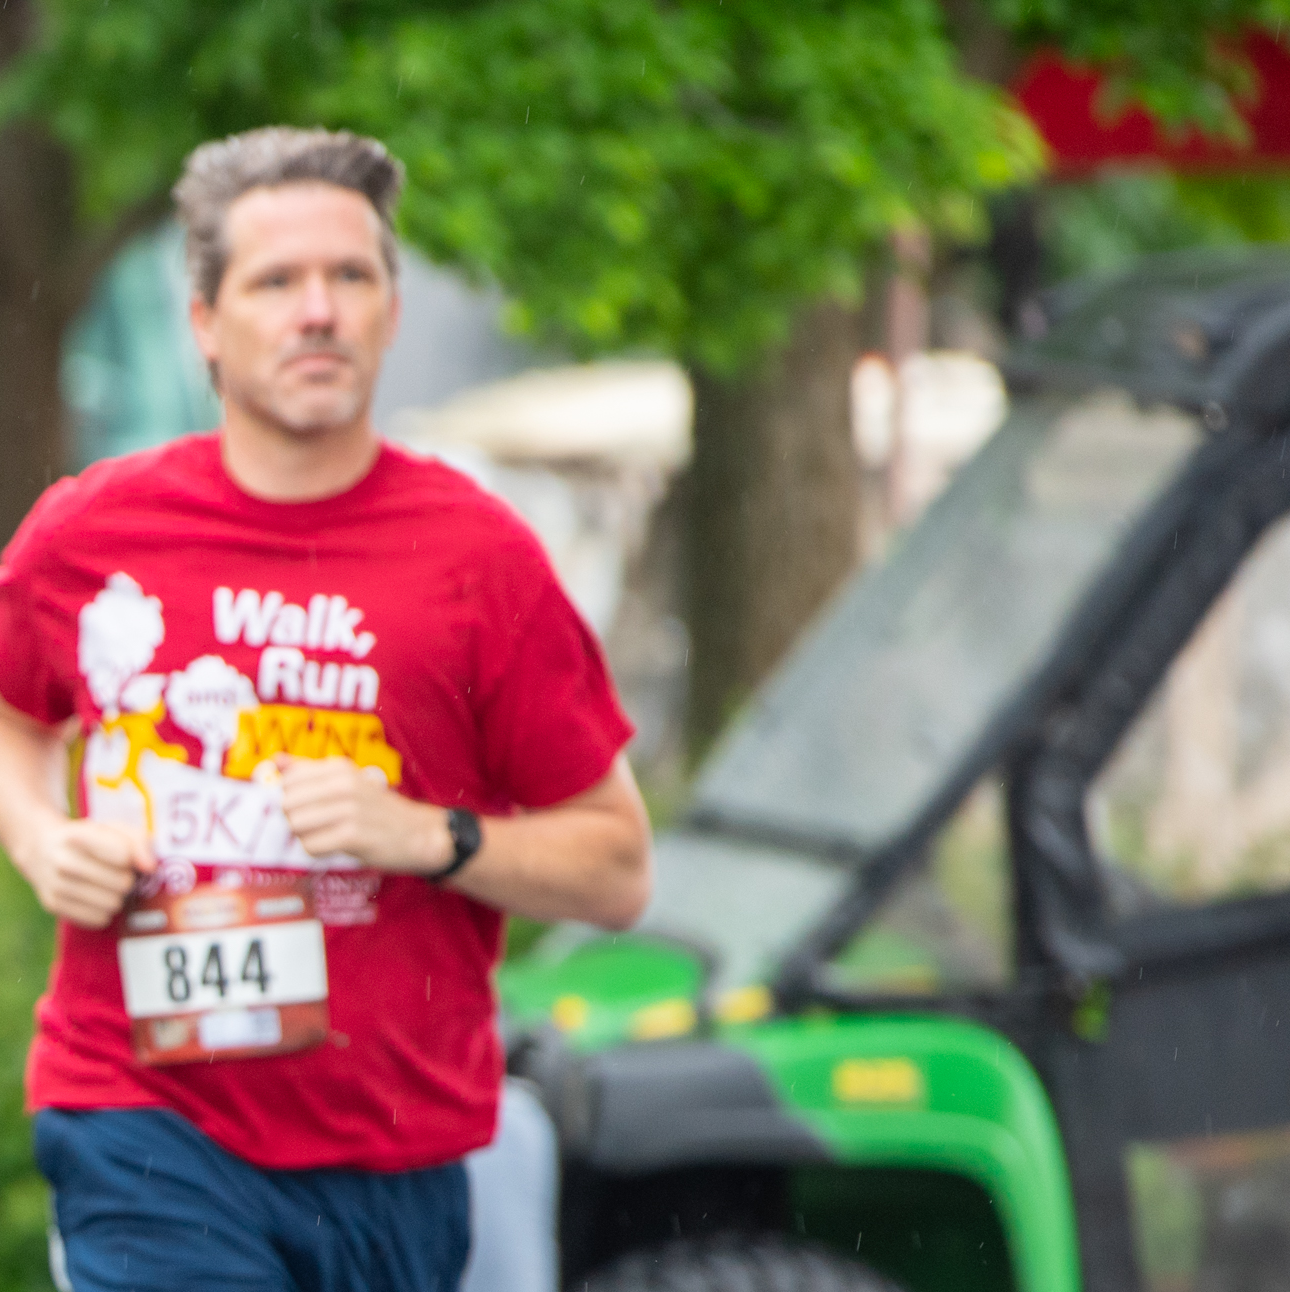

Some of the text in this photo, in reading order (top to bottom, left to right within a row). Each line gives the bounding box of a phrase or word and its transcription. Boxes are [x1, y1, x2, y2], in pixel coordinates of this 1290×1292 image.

[213, 586, 377, 660] Walk,
[258, 646, 381, 712] Run
[164, 938, 270, 1003] 844
